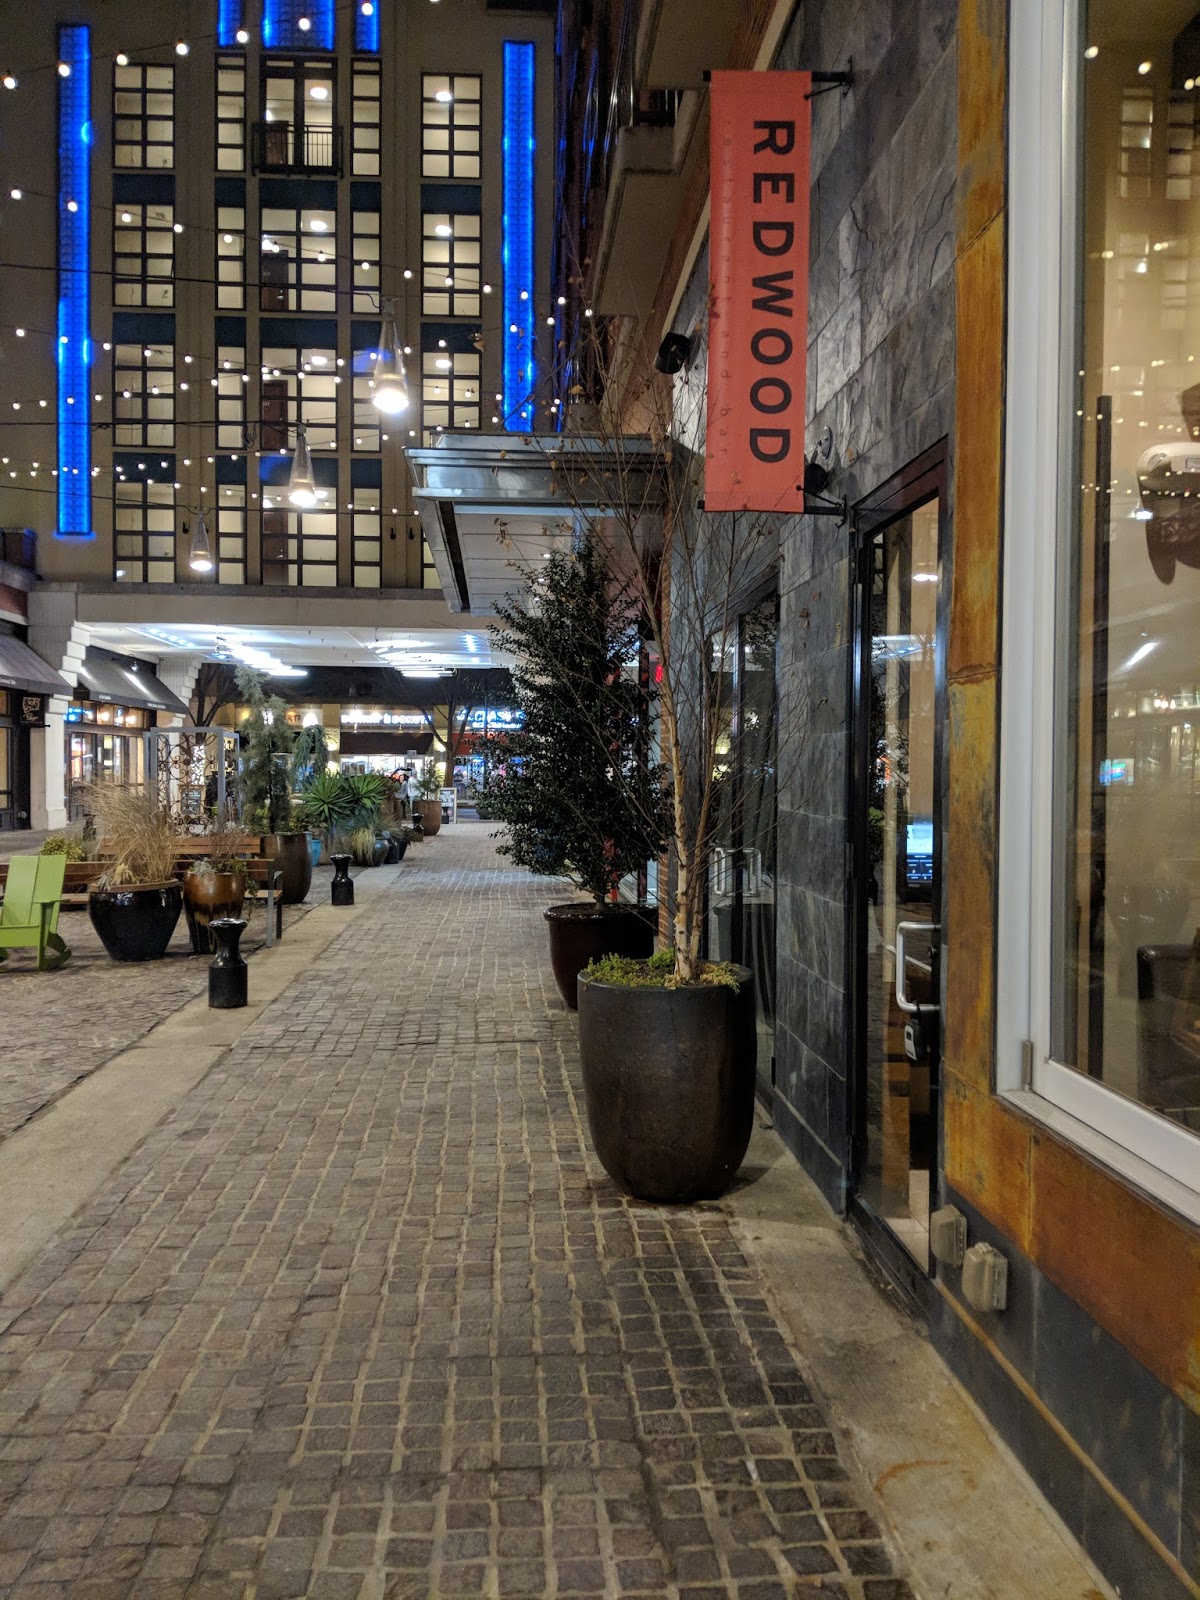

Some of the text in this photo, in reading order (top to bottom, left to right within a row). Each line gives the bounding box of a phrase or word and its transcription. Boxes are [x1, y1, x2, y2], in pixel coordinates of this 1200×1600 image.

[719, 119, 734, 454] restaurant and bar
[750, 120, 796, 463] REDWOOD
